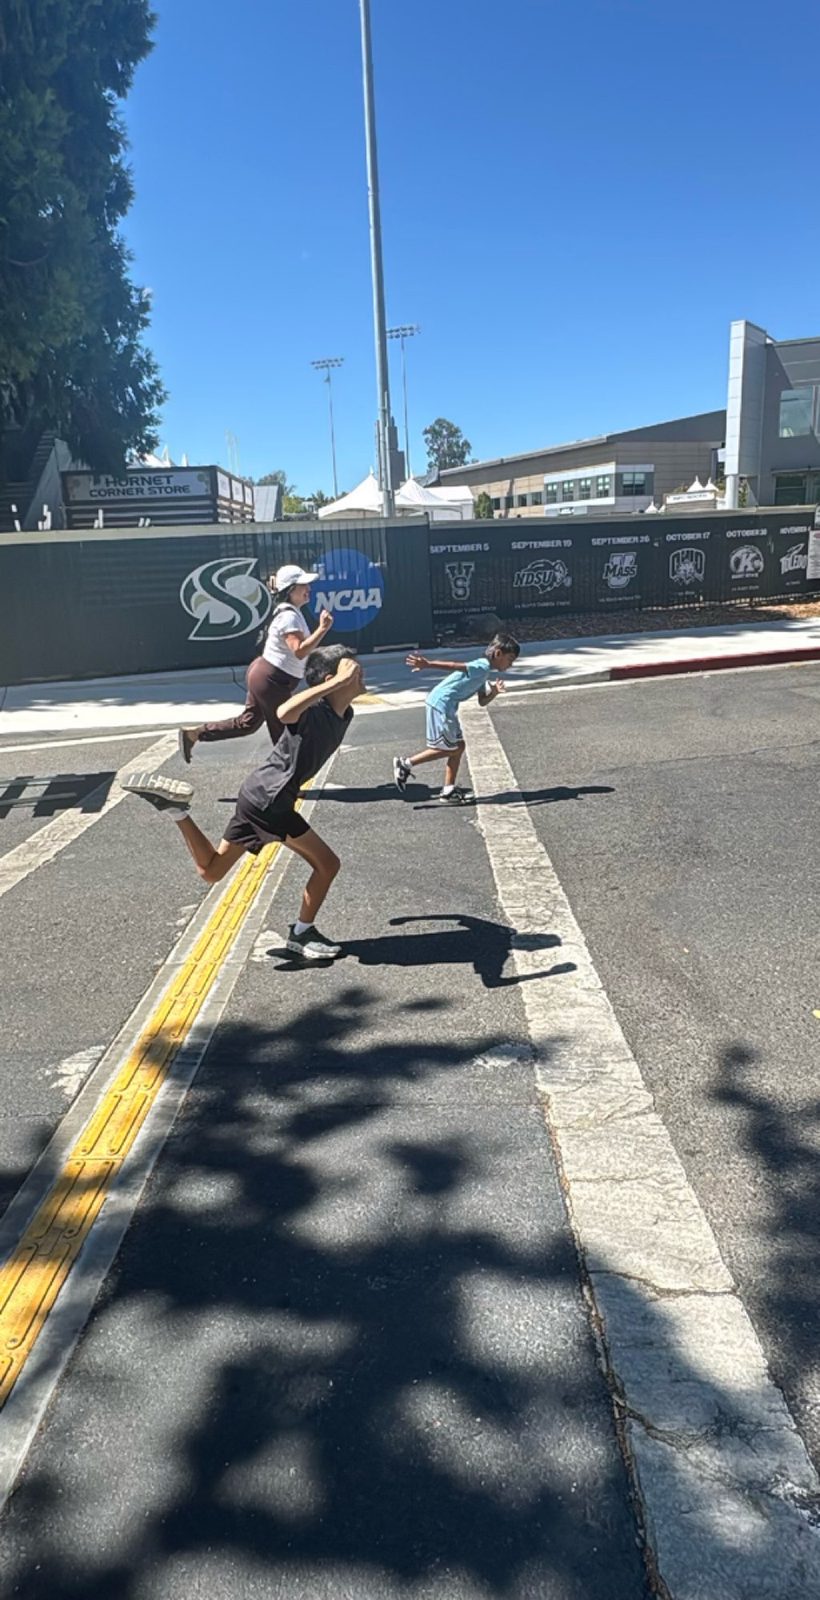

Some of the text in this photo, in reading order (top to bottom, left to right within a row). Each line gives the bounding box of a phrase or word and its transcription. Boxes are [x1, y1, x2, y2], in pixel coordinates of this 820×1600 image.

[89, 485, 191, 497] CORNER STORE
[666, 533, 701, 541] OCTOBER
[726, 529, 758, 538] OCTOBER
[511, 540, 561, 549] SEPTEMBER
[591, 537, 638, 545] SEPTEMBER
[430, 544, 482, 553] SEPTEMBER
[513, 571, 553, 587] NDSU
[315, 587, 382, 613] NCAA
